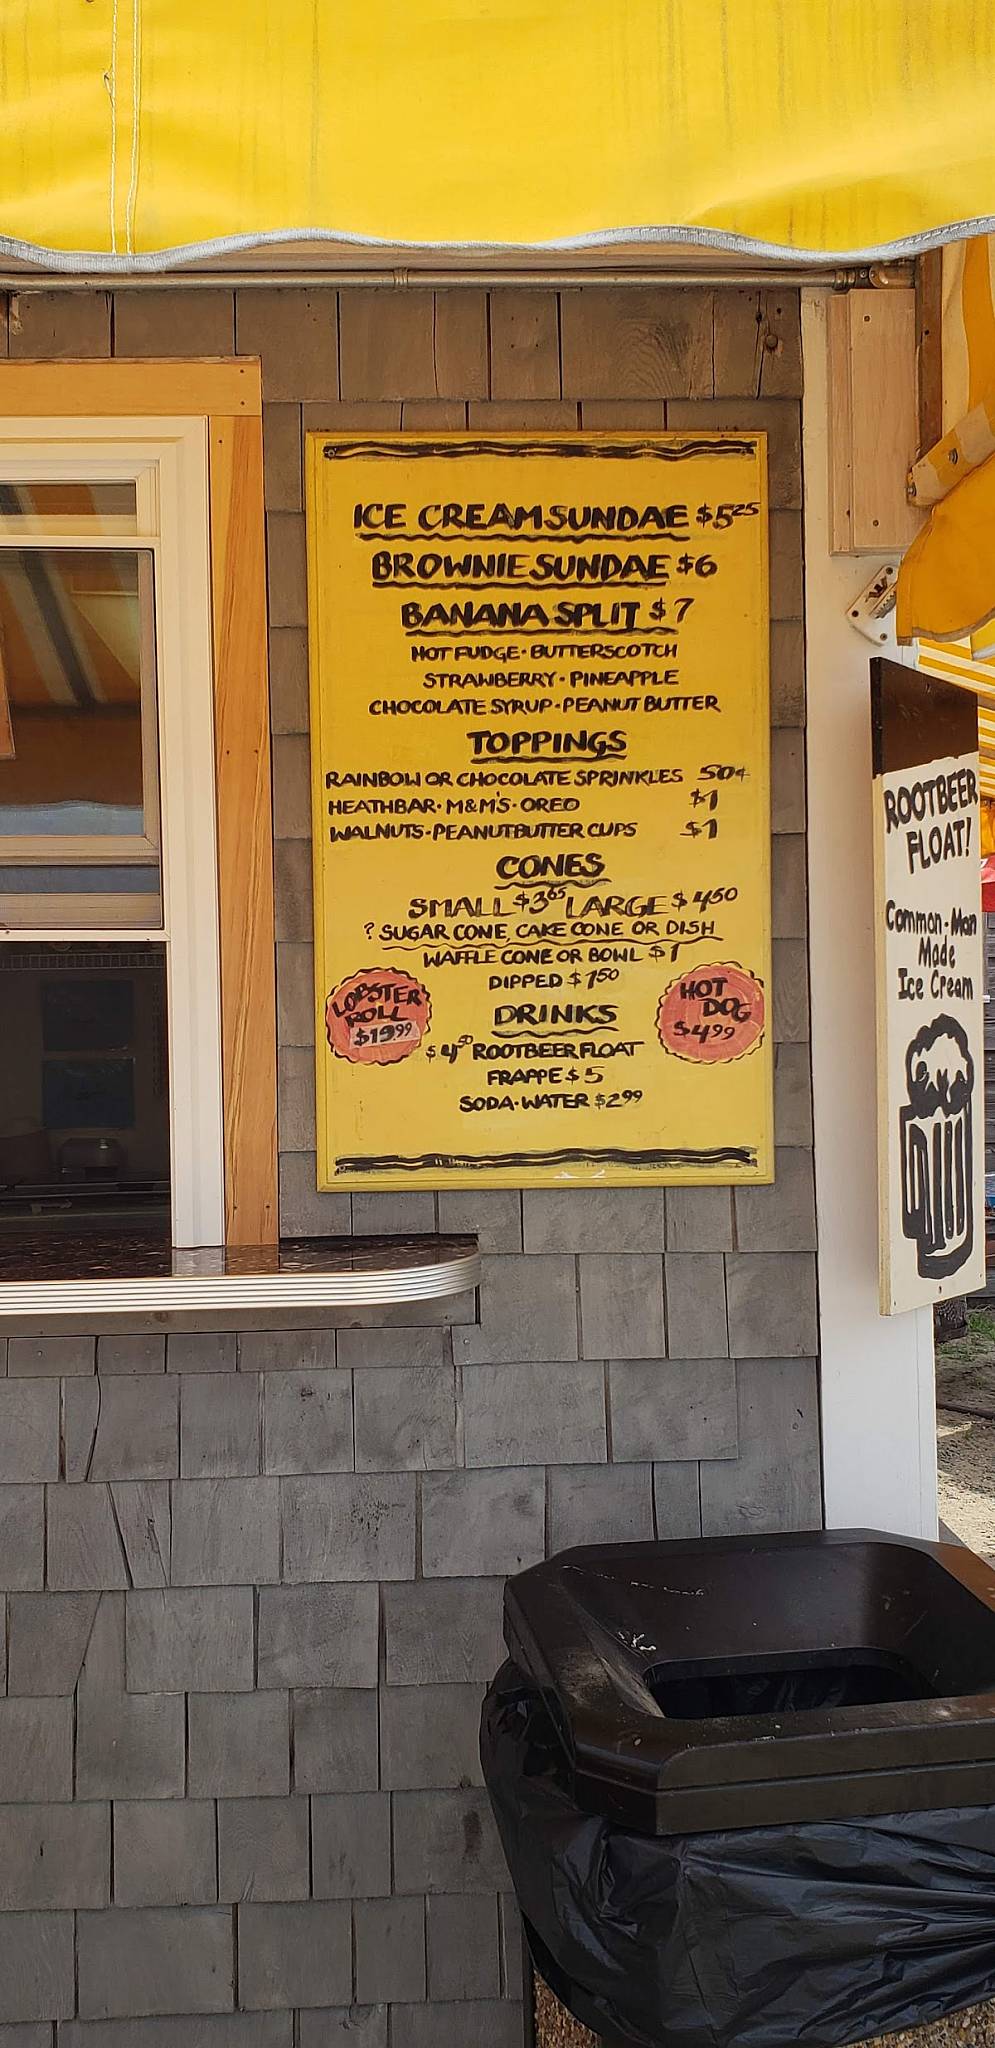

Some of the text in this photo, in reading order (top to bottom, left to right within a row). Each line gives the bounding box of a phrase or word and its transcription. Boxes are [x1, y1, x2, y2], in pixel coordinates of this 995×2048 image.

[353, 503, 407, 529] ICE
[676, 553, 718, 578] $6
[401, 601, 550, 628] BANANA
[553, 601, 641, 630] SPLIT
[411, 646, 453, 662] HOT
[530, 643, 678, 659] BUTTERSCOTCH
[423, 669, 680, 688] STRAWBERRY PINEAPPLE
[369, 699, 487, 716] CHOCOLATE
[643, 695, 722, 713] BUTTER
[467, 729, 627, 757] TOPPINGS
[325, 771, 421, 788] RAINBOW
[425, 772, 453, 787] OR
[456, 771, 571, 787] CHOCOLATE
[574, 768, 684, 787] SPRINKLES
[689, 788, 719, 812] $1
[883, 767, 978, 834] ROOTBEER
[587, 822, 638, 838] CUPS
[680, 818, 718, 839] $1
[906, 816, 972, 874] FLOAT!
[496, 852, 606, 880] CONES
[408, 896, 517, 919] SMALL
[565, 895, 669, 920] LARGE
[379, 923, 450, 942] SUGAR
[515, 922, 567, 940] CAKE
[570, 921, 624, 937] CONE
[631, 921, 660, 936] OR
[666, 920, 715, 935] DISH
[423, 949, 498, 968] WAFFLE
[500, 949, 554, 965] CONE
[556, 950, 583, 965] OR
[588, 947, 643, 963] BOWL
[918, 934, 956, 970] Made
[488, 973, 563, 991] DIPPED
[680, 977, 728, 999] HOT
[897, 967, 974, 1001] Ice Cream
[344, 1005, 409, 1028] ROLL
[494, 1004, 619, 1026] DRINKS
[703, 998, 752, 1022] DOG
[579, 1041, 645, 1060] FLOAT
[487, 1067, 563, 1086] FRAPPE
[521, 1093, 591, 1112] WATER
